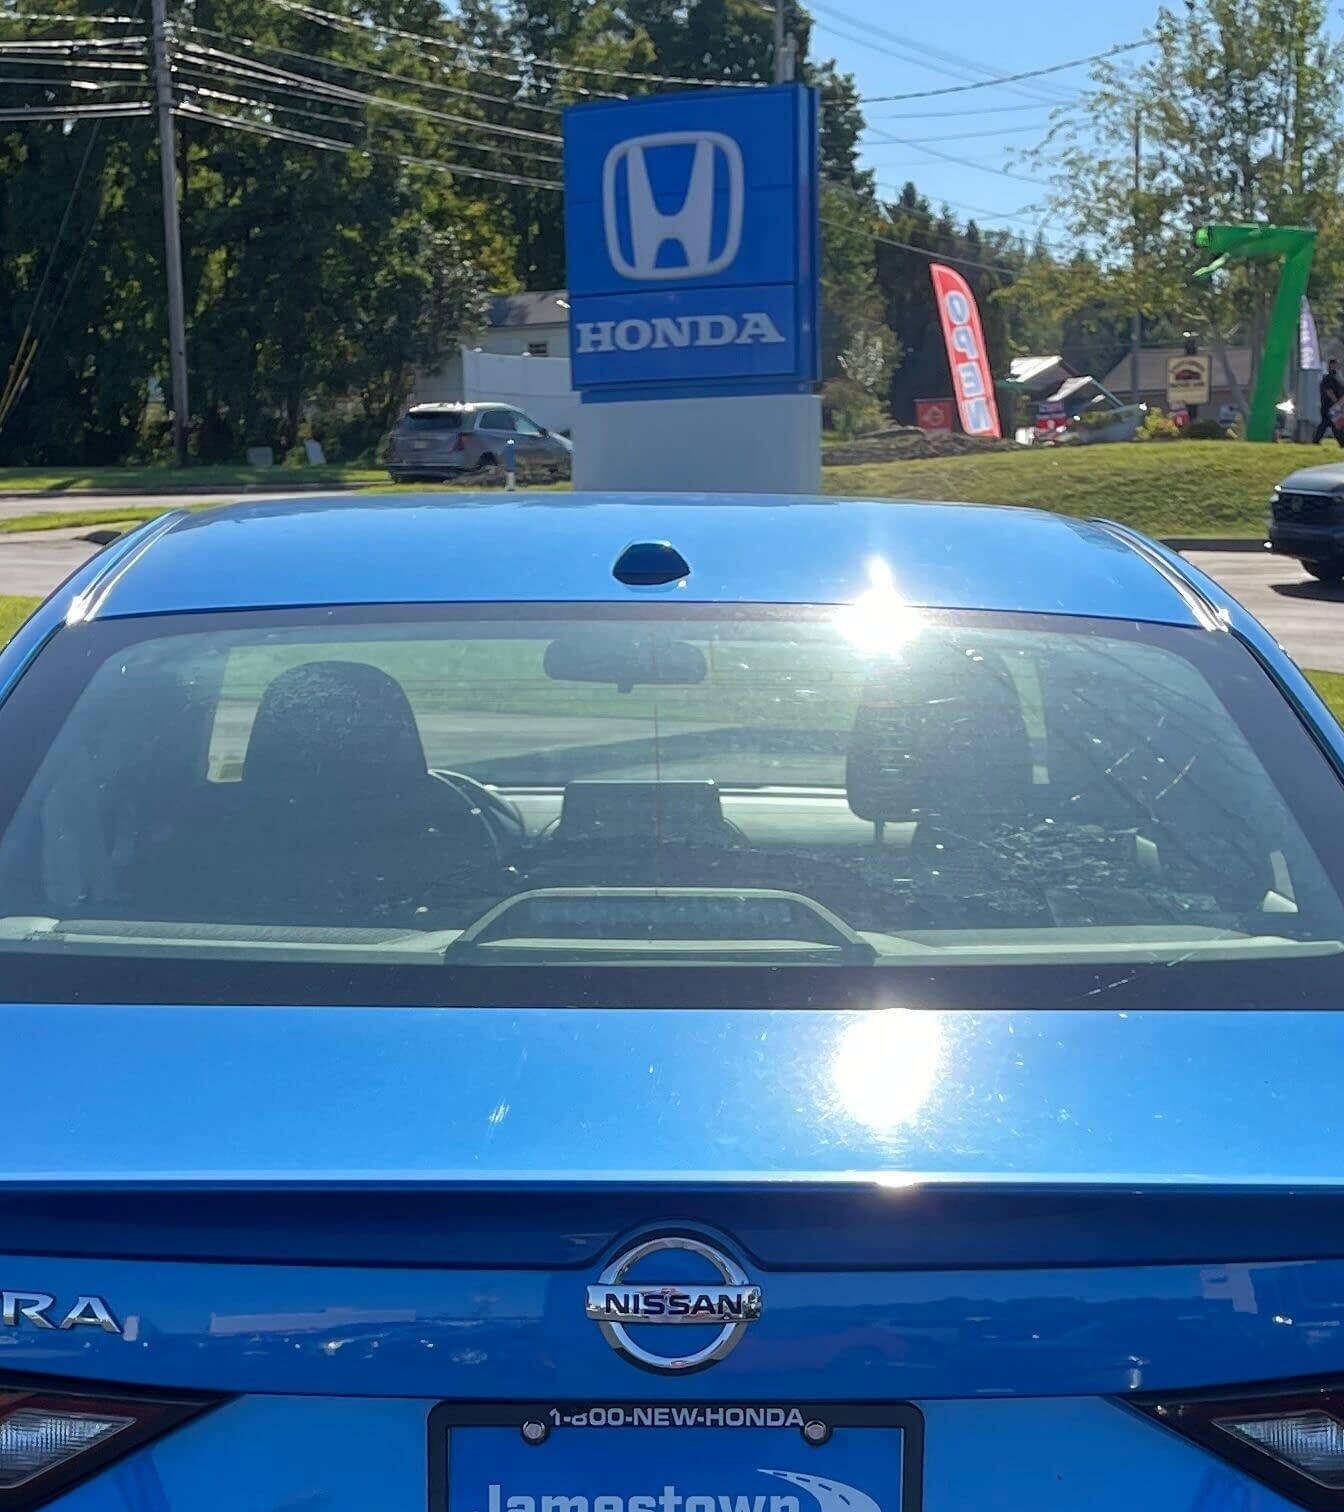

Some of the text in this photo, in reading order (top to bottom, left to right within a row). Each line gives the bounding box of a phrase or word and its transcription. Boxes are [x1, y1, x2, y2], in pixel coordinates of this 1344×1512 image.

[575, 312, 786, 354] HONDA
[605, 1293, 742, 1315] NISSAN
[549, 1407, 804, 1426] 1-800-NEW-HONDA
